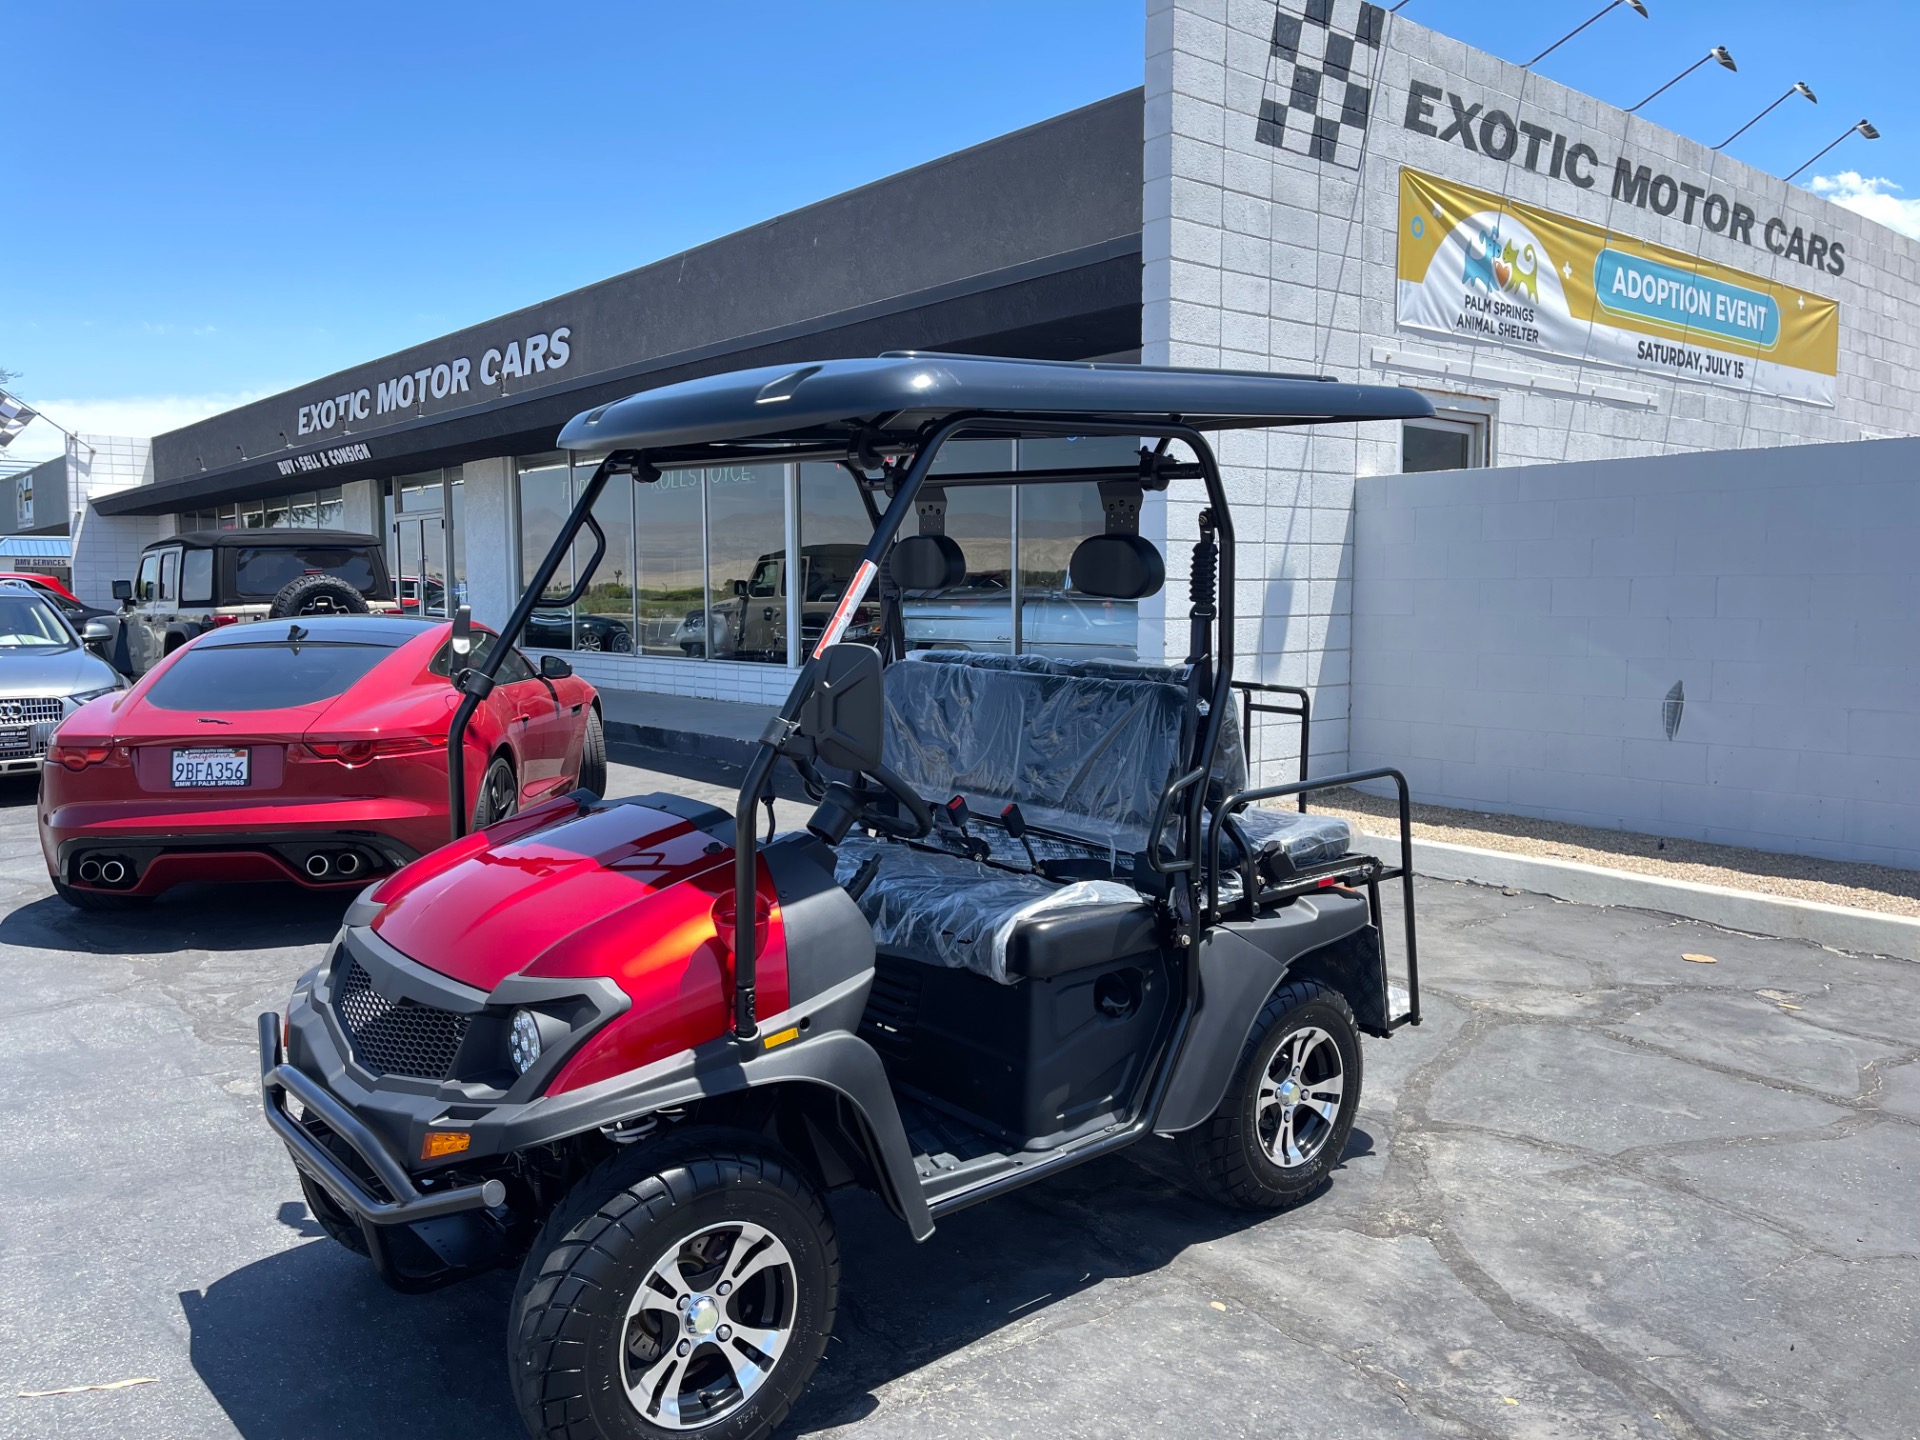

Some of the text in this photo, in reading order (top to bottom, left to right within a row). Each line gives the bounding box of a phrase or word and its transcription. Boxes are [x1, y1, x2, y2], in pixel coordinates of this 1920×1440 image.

[1404, 79, 1845, 277] EXOTIC MOTOR CARS
[1464, 294, 1534, 323] PALM SPRINGS
[1612, 266, 1768, 331] ADOPTION EVENT
[1456, 313, 1539, 343] ANIMAL SHELTER
[1637, 340, 1744, 379] SATURDAY, JULY 15
[298, 327, 571, 435] EXOTIC MOTOR CARS
[277, 443, 371, 475] BUY SELL & CONSIGN
[701, 467, 750, 484] OYCE
[15, 558, 67, 567] DMV SERVICES
[176, 762, 244, 780] 9BFA356
